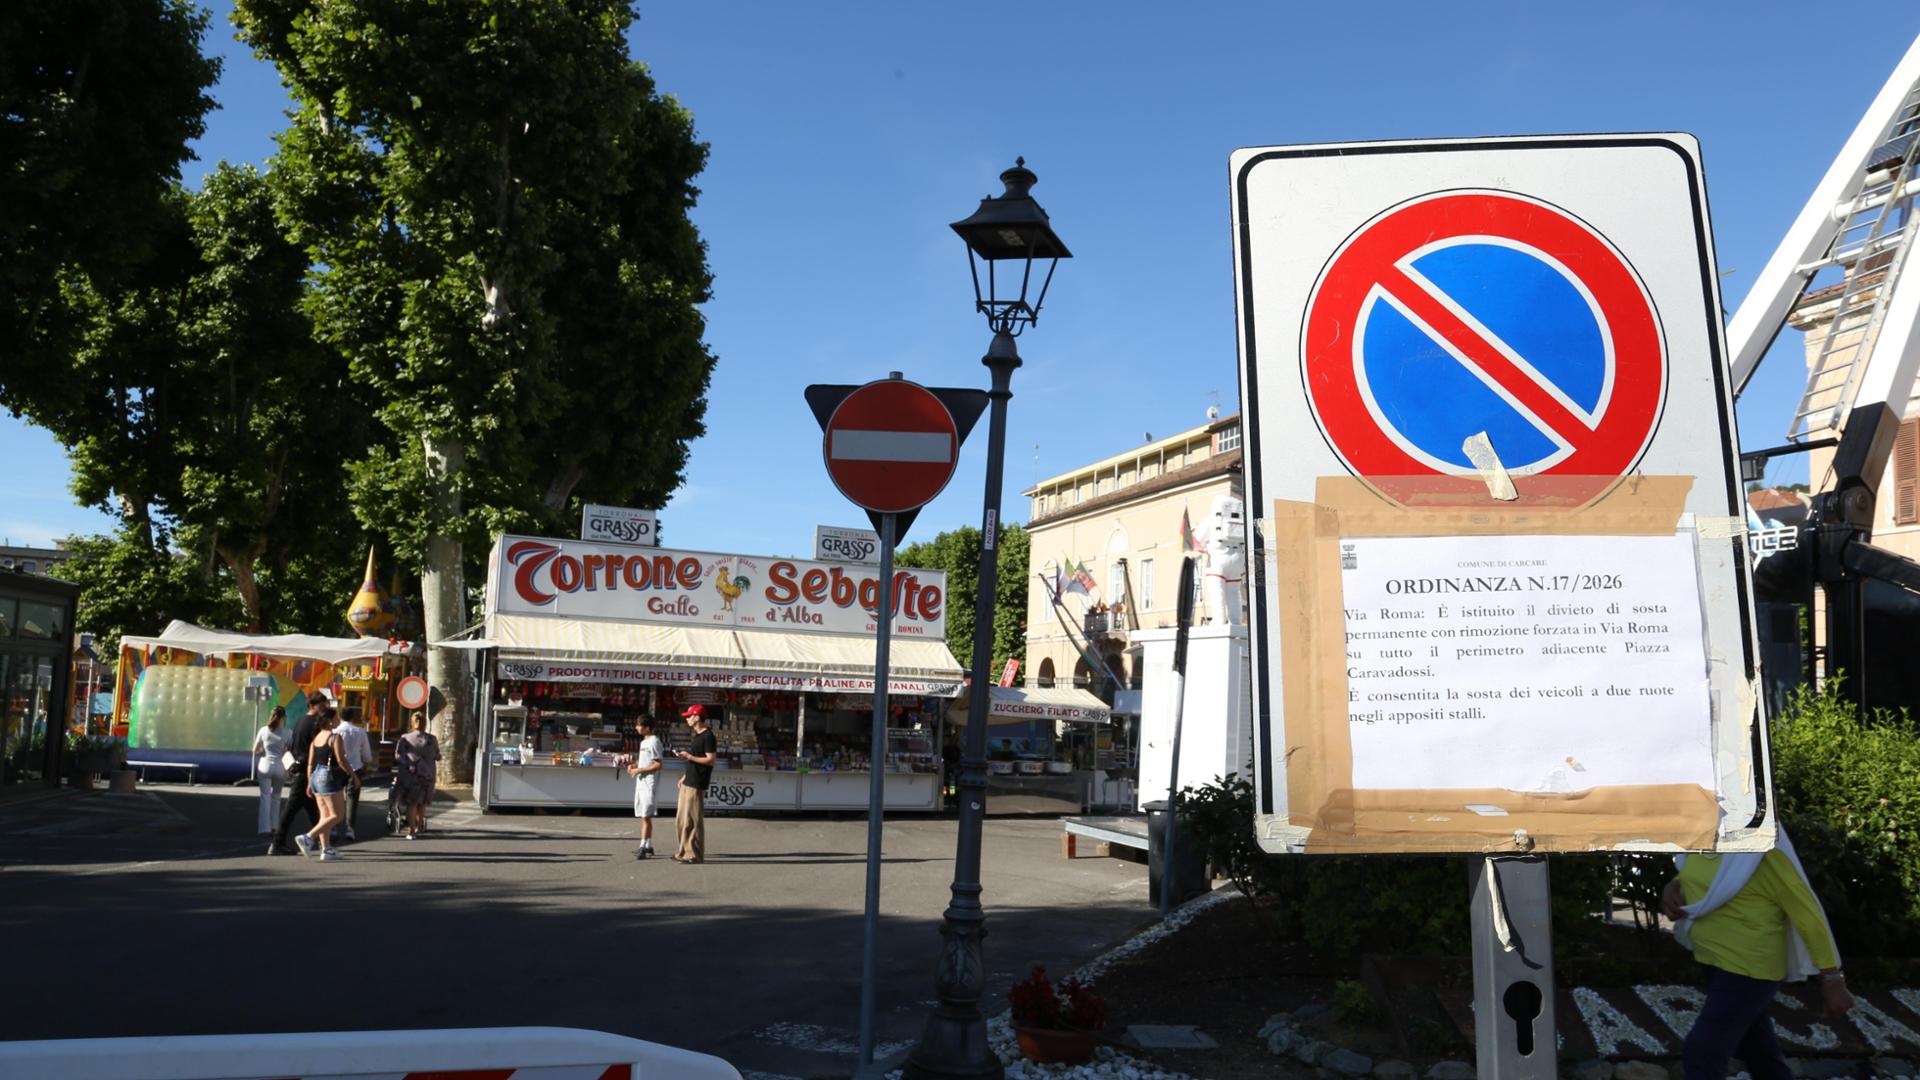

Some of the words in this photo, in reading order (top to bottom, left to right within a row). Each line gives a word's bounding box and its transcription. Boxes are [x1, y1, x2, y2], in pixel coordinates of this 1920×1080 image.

[590, 518, 650, 542] GRASSO
[821, 538, 875, 560] GRASSO
[507, 541, 704, 606] Torrone
[1457, 560, 1496, 569] COMUNE
[1497, 560, 1507, 568] DI
[1508, 559, 1547, 568] CARCARE
[1385, 577, 1523, 595] ORDINANZA
[1527, 574, 1623, 593] N.17/2026
[1344, 608, 1368, 621] Via
[1380, 607, 1425, 620] Roma:
[1438, 603, 1449, 618] È
[1461, 605, 1515, 618] istituito
[1527, 604, 1536, 616] il
[1547, 603, 1594, 616] divieto
[1606, 602, 1620, 615] di
[1632, 604, 1668, 614] sosta
[1345, 628, 1427, 644] permanente
[1431, 628, 1456, 638] con
[1460, 625, 1530, 638] rimozione
[1533, 624, 1580, 636] forzata
[1584, 623, 1596, 635] in
[1600, 623, 1624, 635] Via
[1628, 622, 1669, 634] Roma
[1346, 651, 1362, 660] su
[1380, 649, 1413, 659] tutto
[1430, 646, 1439, 658] il
[1457, 645, 1524, 660] perimetro
[1542, 643, 1607, 655] adiacente
[1625, 641, 1670, 654] Piazza
[548, 667, 610, 679] PRODOTTI
[613, 669, 646, 680] TIPICI
[648, 670, 684, 681] DELLE
[687, 672, 733, 683] LANGHE
[740, 675, 806, 687] SPECIALITA'
[809, 678, 855, 689] PRALINE
[1347, 665, 1435, 679] Caravadossi.
[1349, 687, 1360, 702] È
[1367, 689, 1440, 702] consentita
[1447, 688, 1459, 700] la
[1467, 690, 1502, 699] sosta
[1509, 687, 1531, 698] dei
[1538, 686, 1583, 698] veicoli
[1591, 688, 1599, 697] a
[1606, 685, 1631, 696] due
[1639, 686, 1675, 696] ruote
[993, 703, 1044, 714] ZUCCHERO
[1047, 706, 1080, 717] FILATO
[1349, 709, 1384, 724] negli
[1388, 708, 1444, 724] appositi
[1448, 707, 1486, 720] stalli.
